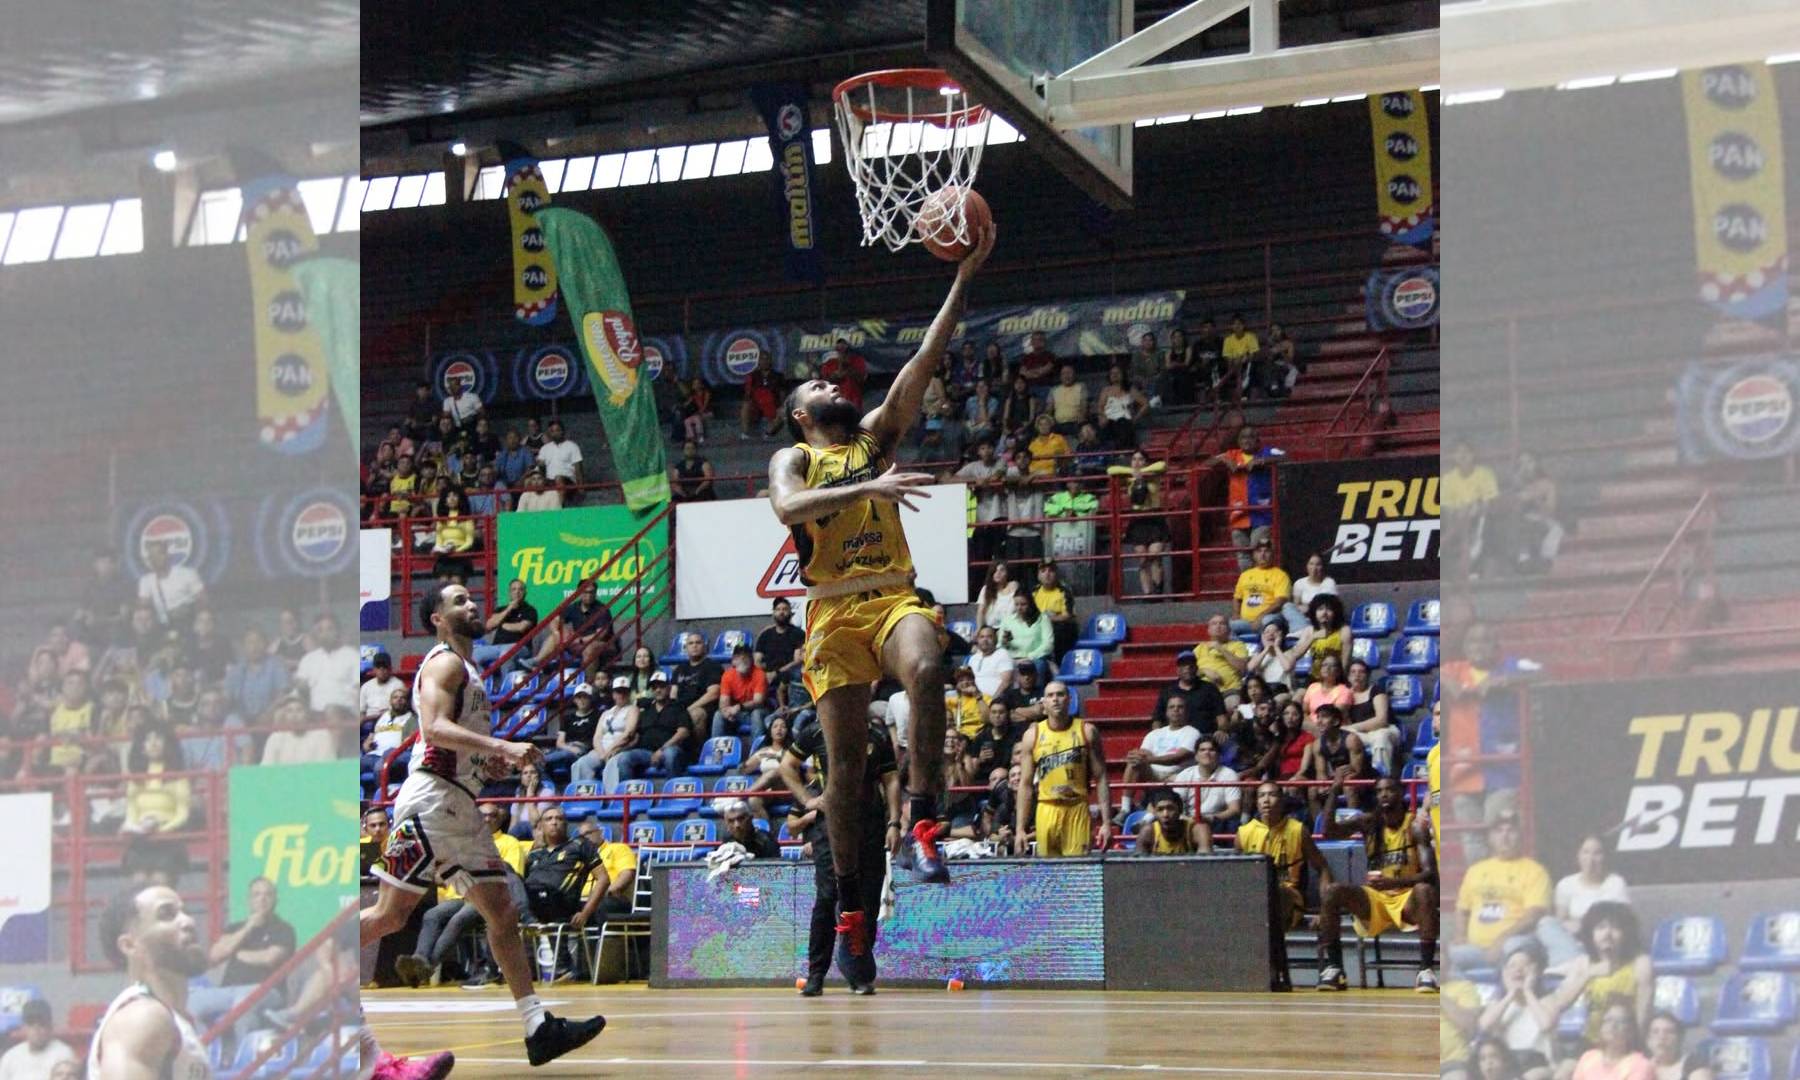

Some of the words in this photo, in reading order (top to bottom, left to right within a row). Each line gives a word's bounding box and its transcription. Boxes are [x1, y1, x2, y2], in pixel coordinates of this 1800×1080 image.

[1702, 74, 1757, 97] PAN
[1381, 94, 1414, 112] PAN
[1385, 140, 1419, 156] PAN
[1708, 145, 1766, 171] PAN
[1388, 182, 1421, 198] PAN
[1714, 215, 1769, 241] PAN
[523, 271, 549, 285] PAN
[1397, 291, 1433, 305] PEPSI
[998, 307, 1070, 334] maltin
[1102, 297, 1175, 325] maltin
[604, 316, 640, 363] Royal
[728, 352, 759, 362] PEPSI
[272, 365, 313, 385] PAN
[537, 366, 566, 377] PEPSI
[1728, 397, 1788, 420] PEPSI
[297, 523, 343, 540] PEPSI
[842, 530, 883, 551] mavesa
[511, 546, 649, 585] Fiorella
